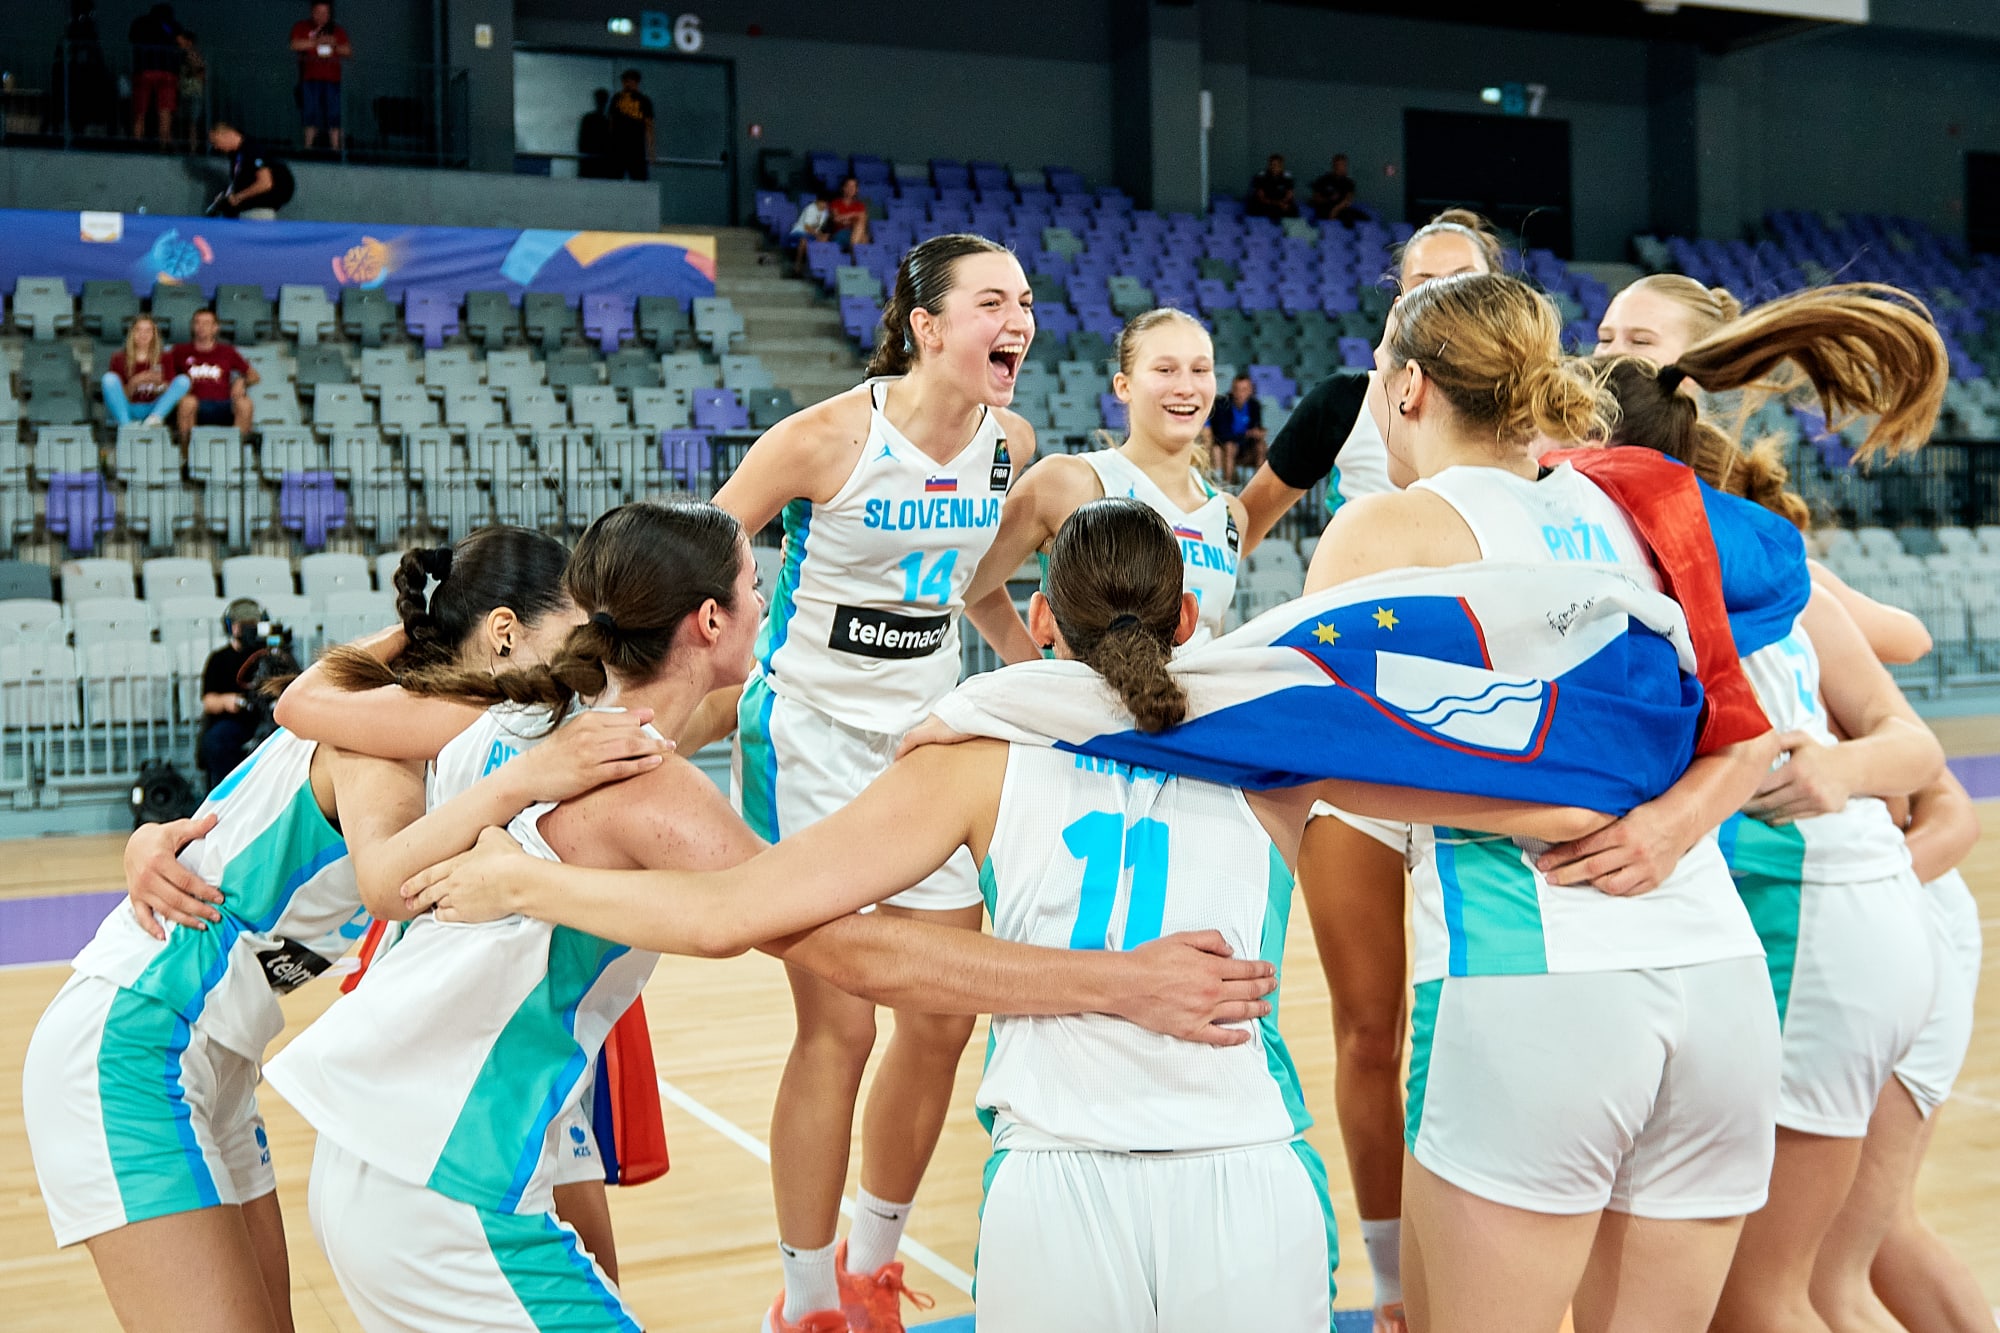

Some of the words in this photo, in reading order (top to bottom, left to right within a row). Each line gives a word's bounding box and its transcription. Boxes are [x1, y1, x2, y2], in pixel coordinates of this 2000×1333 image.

[640, 10, 703, 53] B6
[863, 498, 999, 531] SLOVENIJA
[898, 548, 958, 605] 14
[1061, 810, 1169, 951] 11
